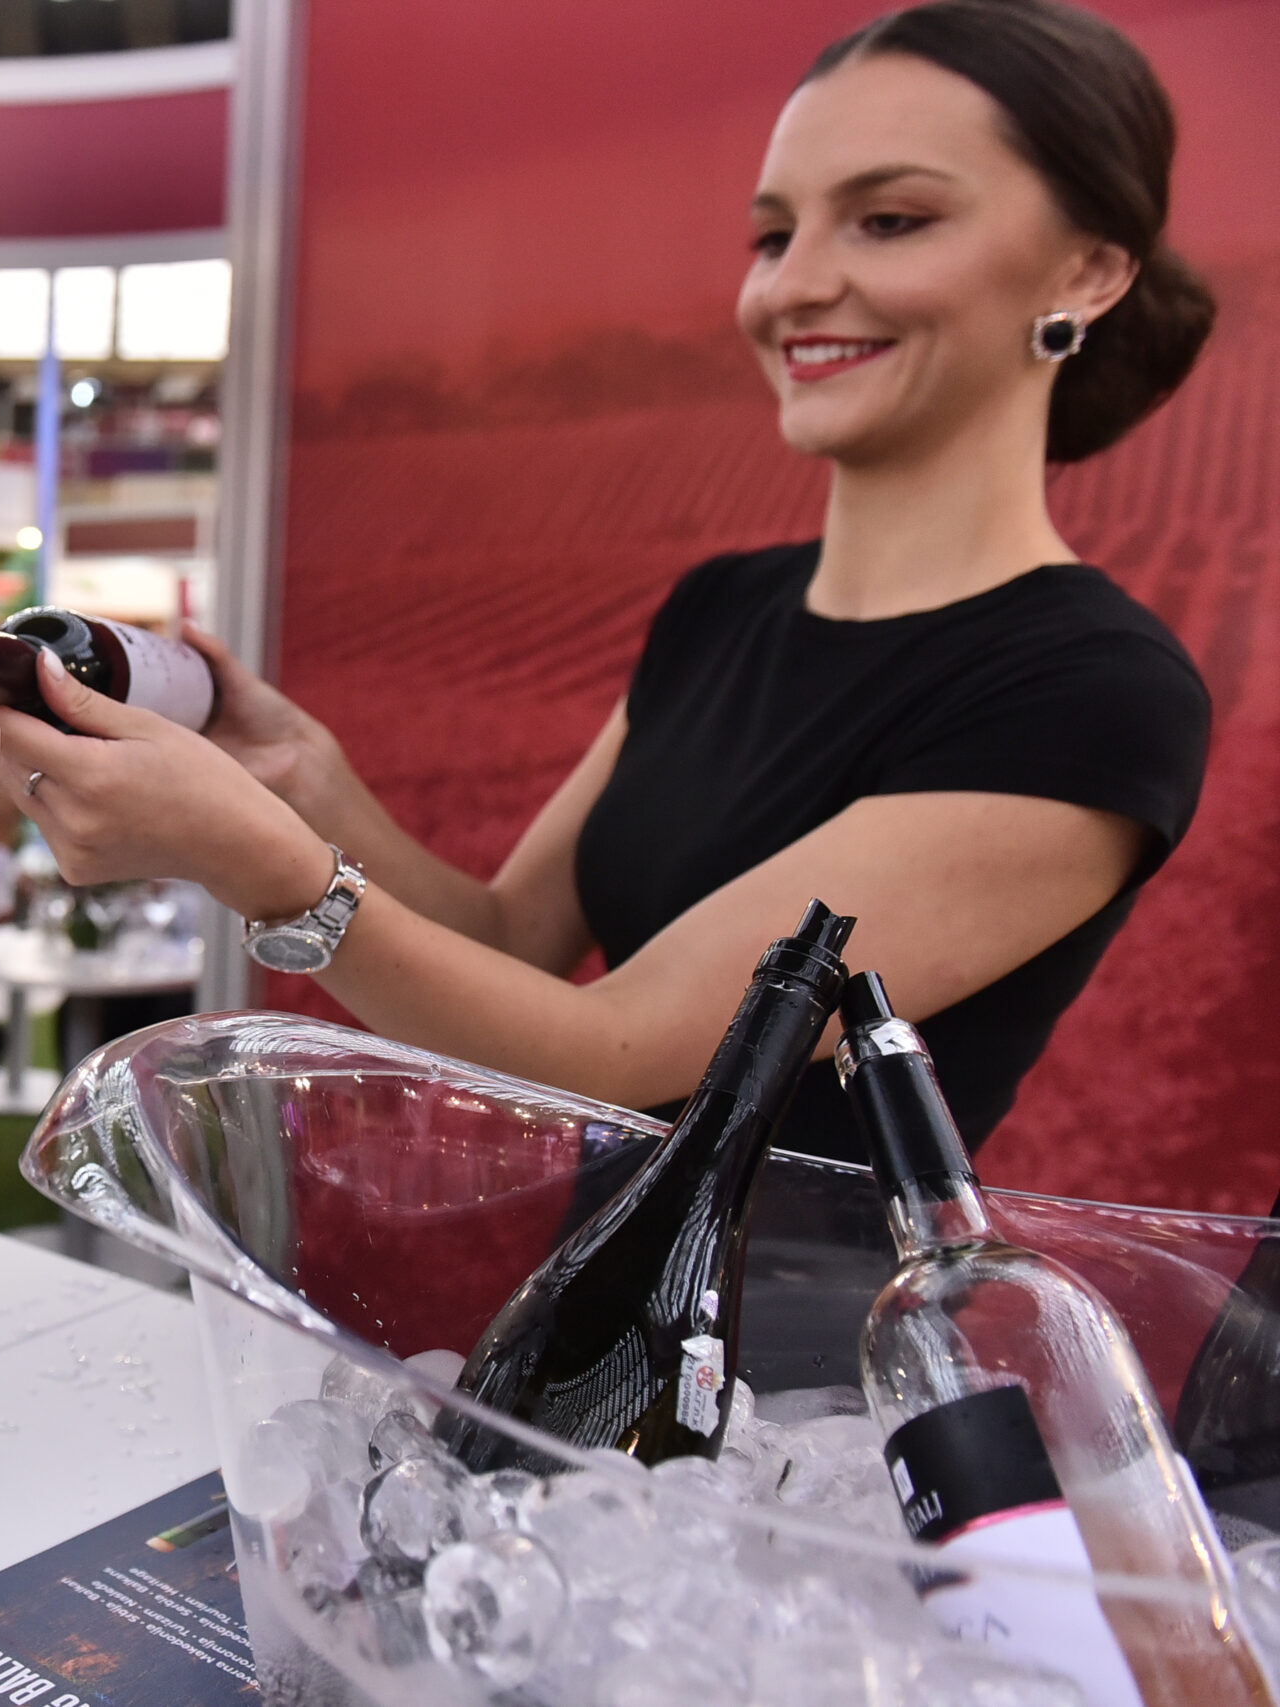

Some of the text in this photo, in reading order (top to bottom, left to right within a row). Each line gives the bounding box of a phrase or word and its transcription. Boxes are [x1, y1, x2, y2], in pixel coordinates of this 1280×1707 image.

[61, 1577, 101, 1602] Balkan
[128, 1567, 232, 1625] Tourism Heritage
[103, 1566, 254, 1651] acedonia Serbia Balkans
[106, 1601, 140, 1624] Srbija
[143, 1607, 191, 1639] Turizam
[145, 1623, 215, 1664] Makedonija
[197, 1637, 258, 1672] tronomija
